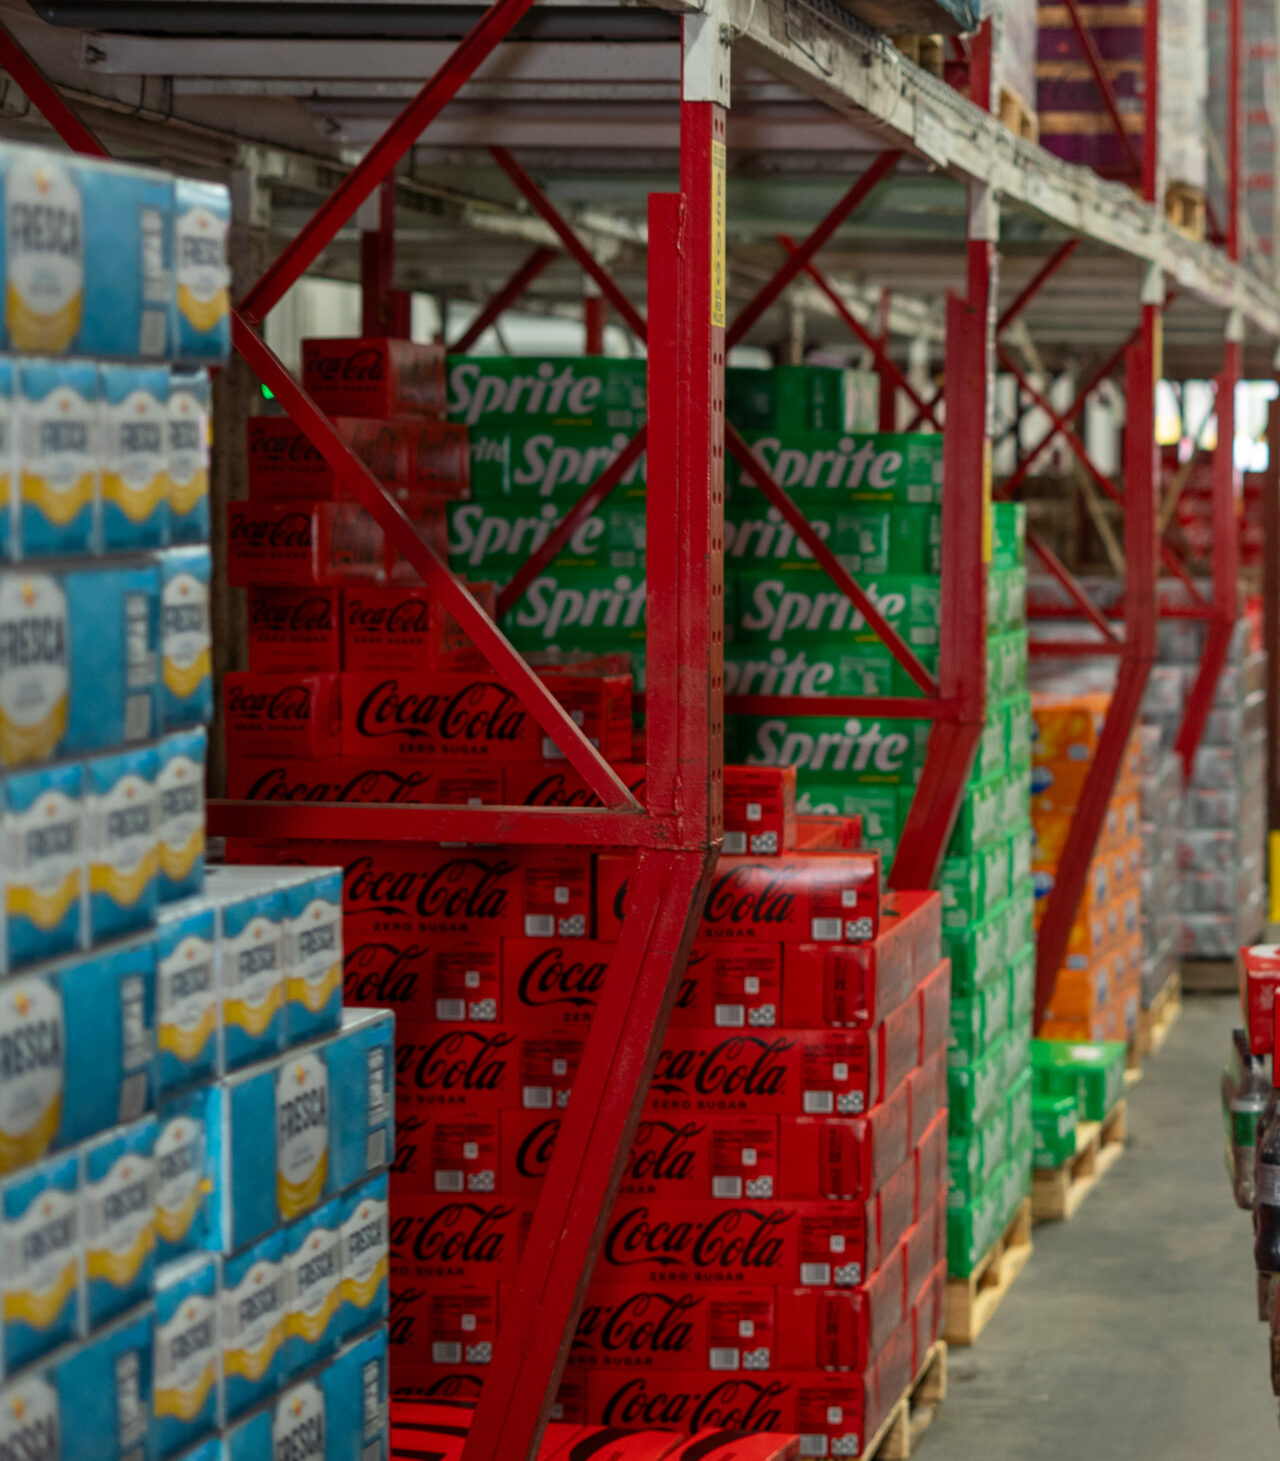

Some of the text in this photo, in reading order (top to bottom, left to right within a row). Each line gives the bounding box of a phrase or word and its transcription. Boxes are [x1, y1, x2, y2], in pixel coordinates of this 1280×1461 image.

[448, 362, 602, 425] Sprite
[450, 503, 606, 566] Sprie
[516, 574, 647, 638] Sprit
[356, 680, 527, 740] Coca-Cola
[399, 744, 489, 755] ZERO SUGAR
[374, 922, 468, 932] ZERO SUGAR
[652, 1100, 747, 1110] ZERO SUGAR
[604, 1207, 797, 1267] Coca-Cola
[415, 1267, 465, 1276] SUGAR
[650, 1271, 744, 1281] ZERO SUGAR
[603, 1357, 653, 1367] SUGAR
